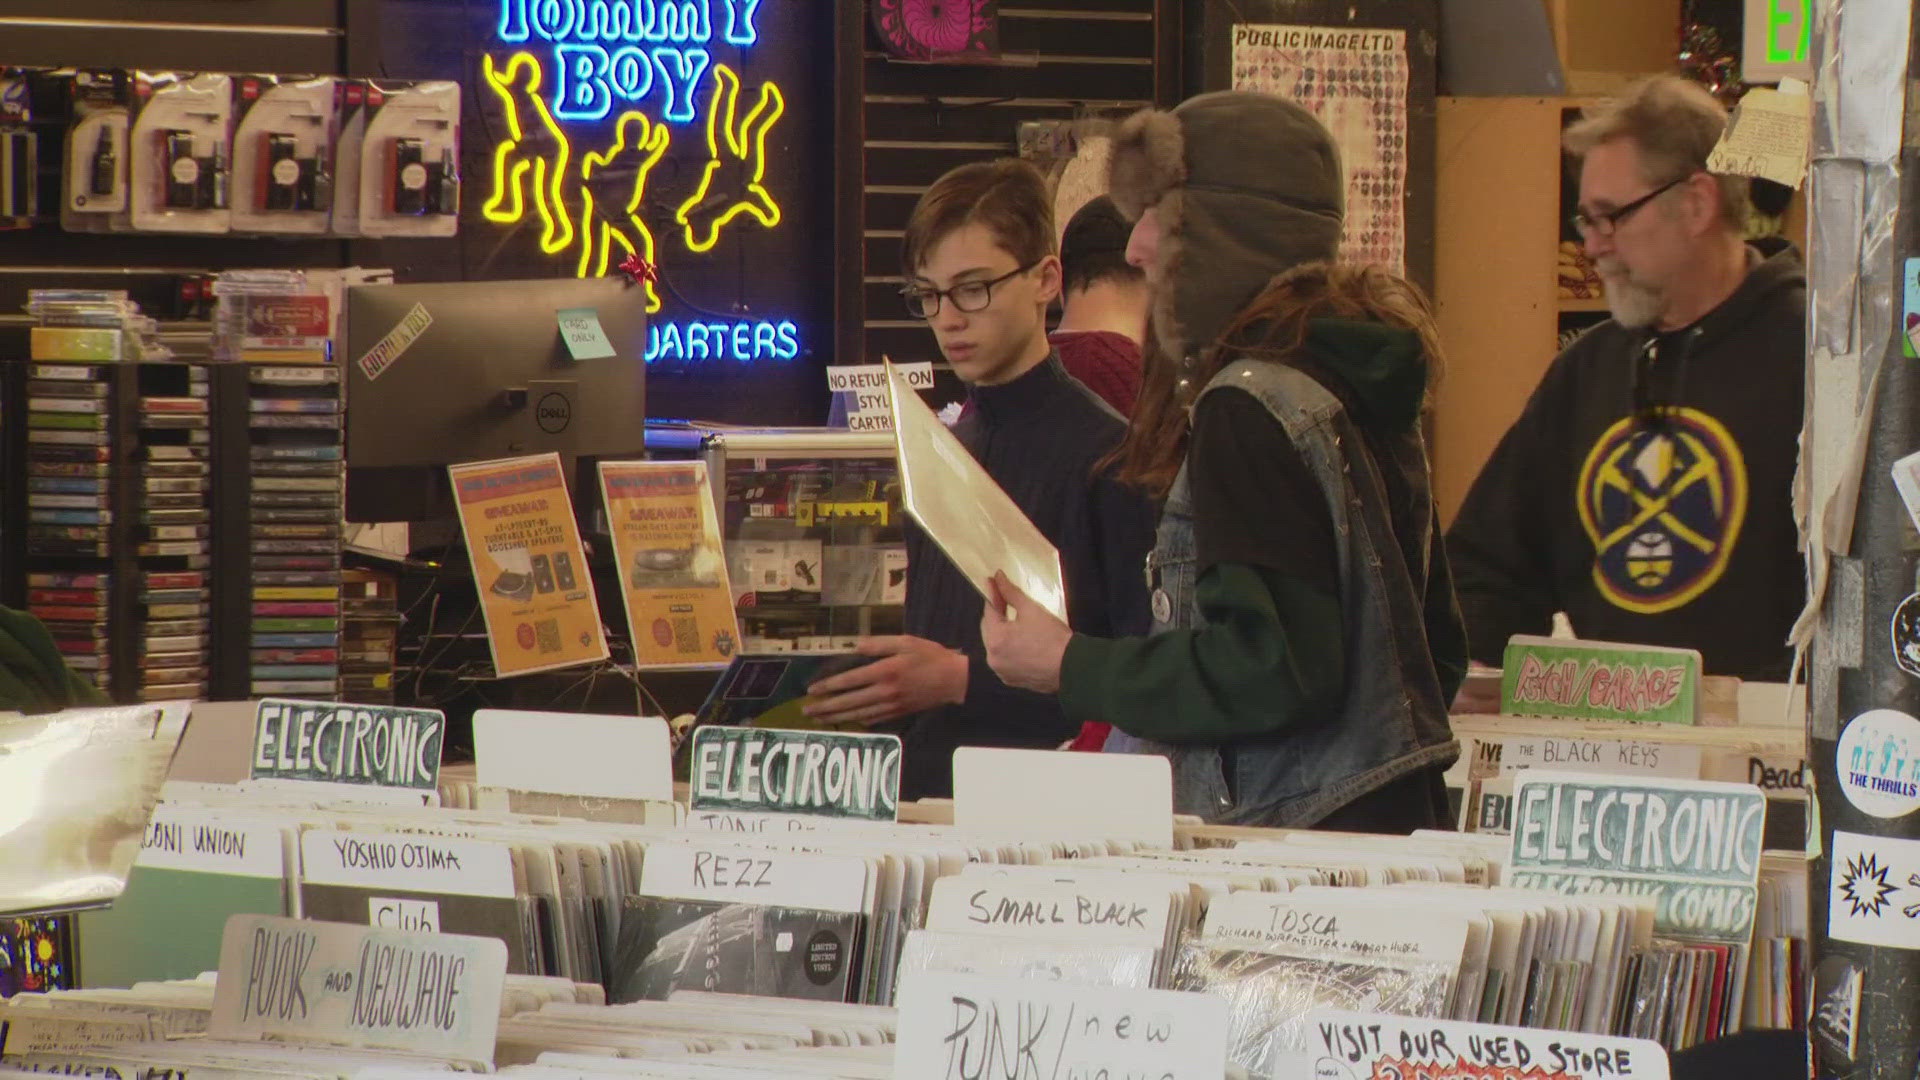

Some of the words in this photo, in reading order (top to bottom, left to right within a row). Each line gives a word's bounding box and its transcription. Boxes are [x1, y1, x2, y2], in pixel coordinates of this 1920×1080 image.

[1235, 30, 1301, 48] PUBLIC
[1303, 33, 1360, 50] IMAGE
[1361, 35, 1394, 51] LTD
[554, 43, 710, 121] BOY
[572, 333, 596, 343] ONLY
[644, 320, 799, 361] UARTERS
[831, 375, 847, 388] NO
[850, 372, 904, 388] RETUR
[908, 370, 932, 386] ON
[541, 408, 568, 418] DELL
[850, 415, 892, 431] CARTRI
[255, 706, 439, 784] ELECTRONIC
[1519, 745, 1534, 756] THE
[1543, 740, 1602, 763] BLACK
[1618, 744, 1660, 768] KEYS
[698, 740, 899, 811] ELECTRONIC
[1749, 757, 1805, 790] Dead
[1849, 771, 1869, 789] THE
[1871, 777, 1918, 798] THRILLS
[141, 821, 183, 854] CONI
[193, 825, 246, 858] UNION
[1520, 784, 1763, 876] ELECTRONIC
[334, 837, 397, 870] YOSHIO
[401, 842, 461, 871] OJIMA
[693, 851, 773, 889] REZZ
[967, 889, 1064, 925] SMALL
[1076, 895, 1148, 930] BLACK
[1270, 904, 1340, 937] TOSCA
[1668, 886, 1753, 933] COMPS
[811, 943, 838, 952] LIMITED
[1216, 925, 1262, 940] RICHARD
[244, 926, 317, 1022] PUNK
[324, 970, 352, 993] AND
[811, 953, 837, 962] EDITION
[813, 963, 833, 972] VINYL
[1319, 1021, 1383, 1062] VISIT
[1400, 1029, 1455, 1059] OUR
[1469, 1030, 1532, 1069] USED
[1550, 1042, 1633, 1075] STORE
